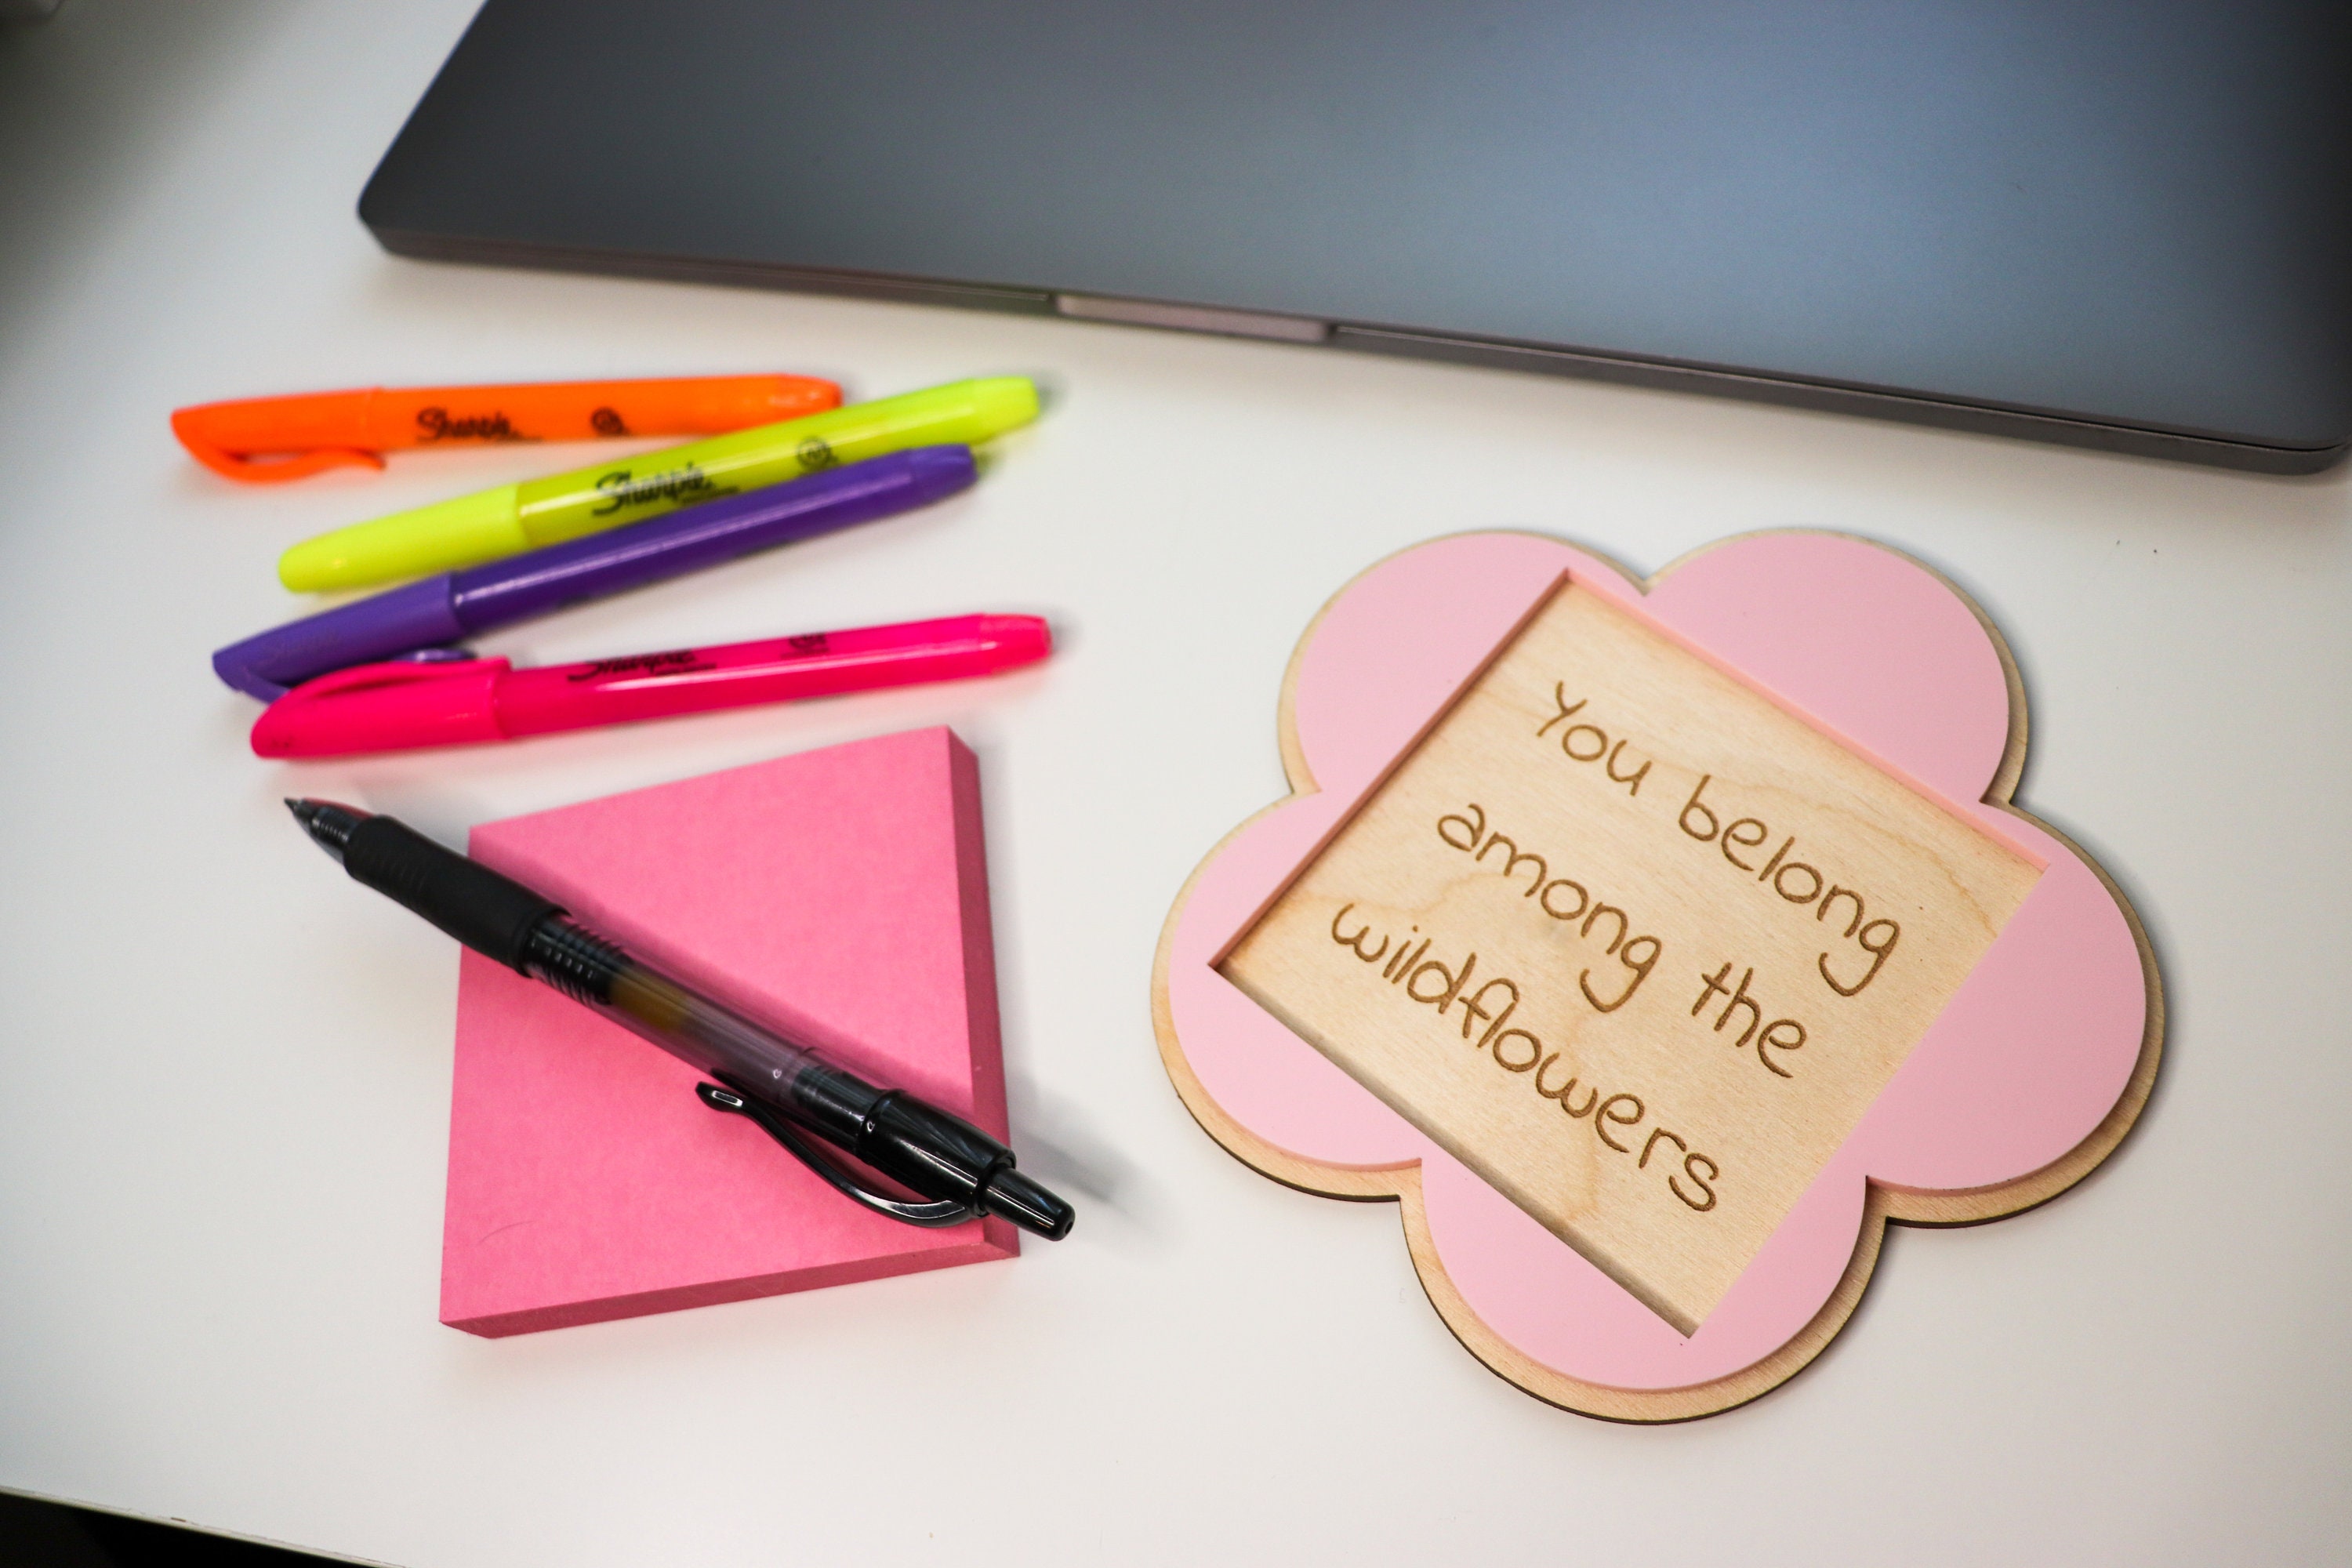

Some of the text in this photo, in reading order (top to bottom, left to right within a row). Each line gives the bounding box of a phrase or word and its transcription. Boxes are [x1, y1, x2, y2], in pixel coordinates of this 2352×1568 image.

[1436, 804, 1808, 1079] among the
[1536, 681, 1901, 998] You belong
[1330, 903, 1720, 1213] wildflowers
